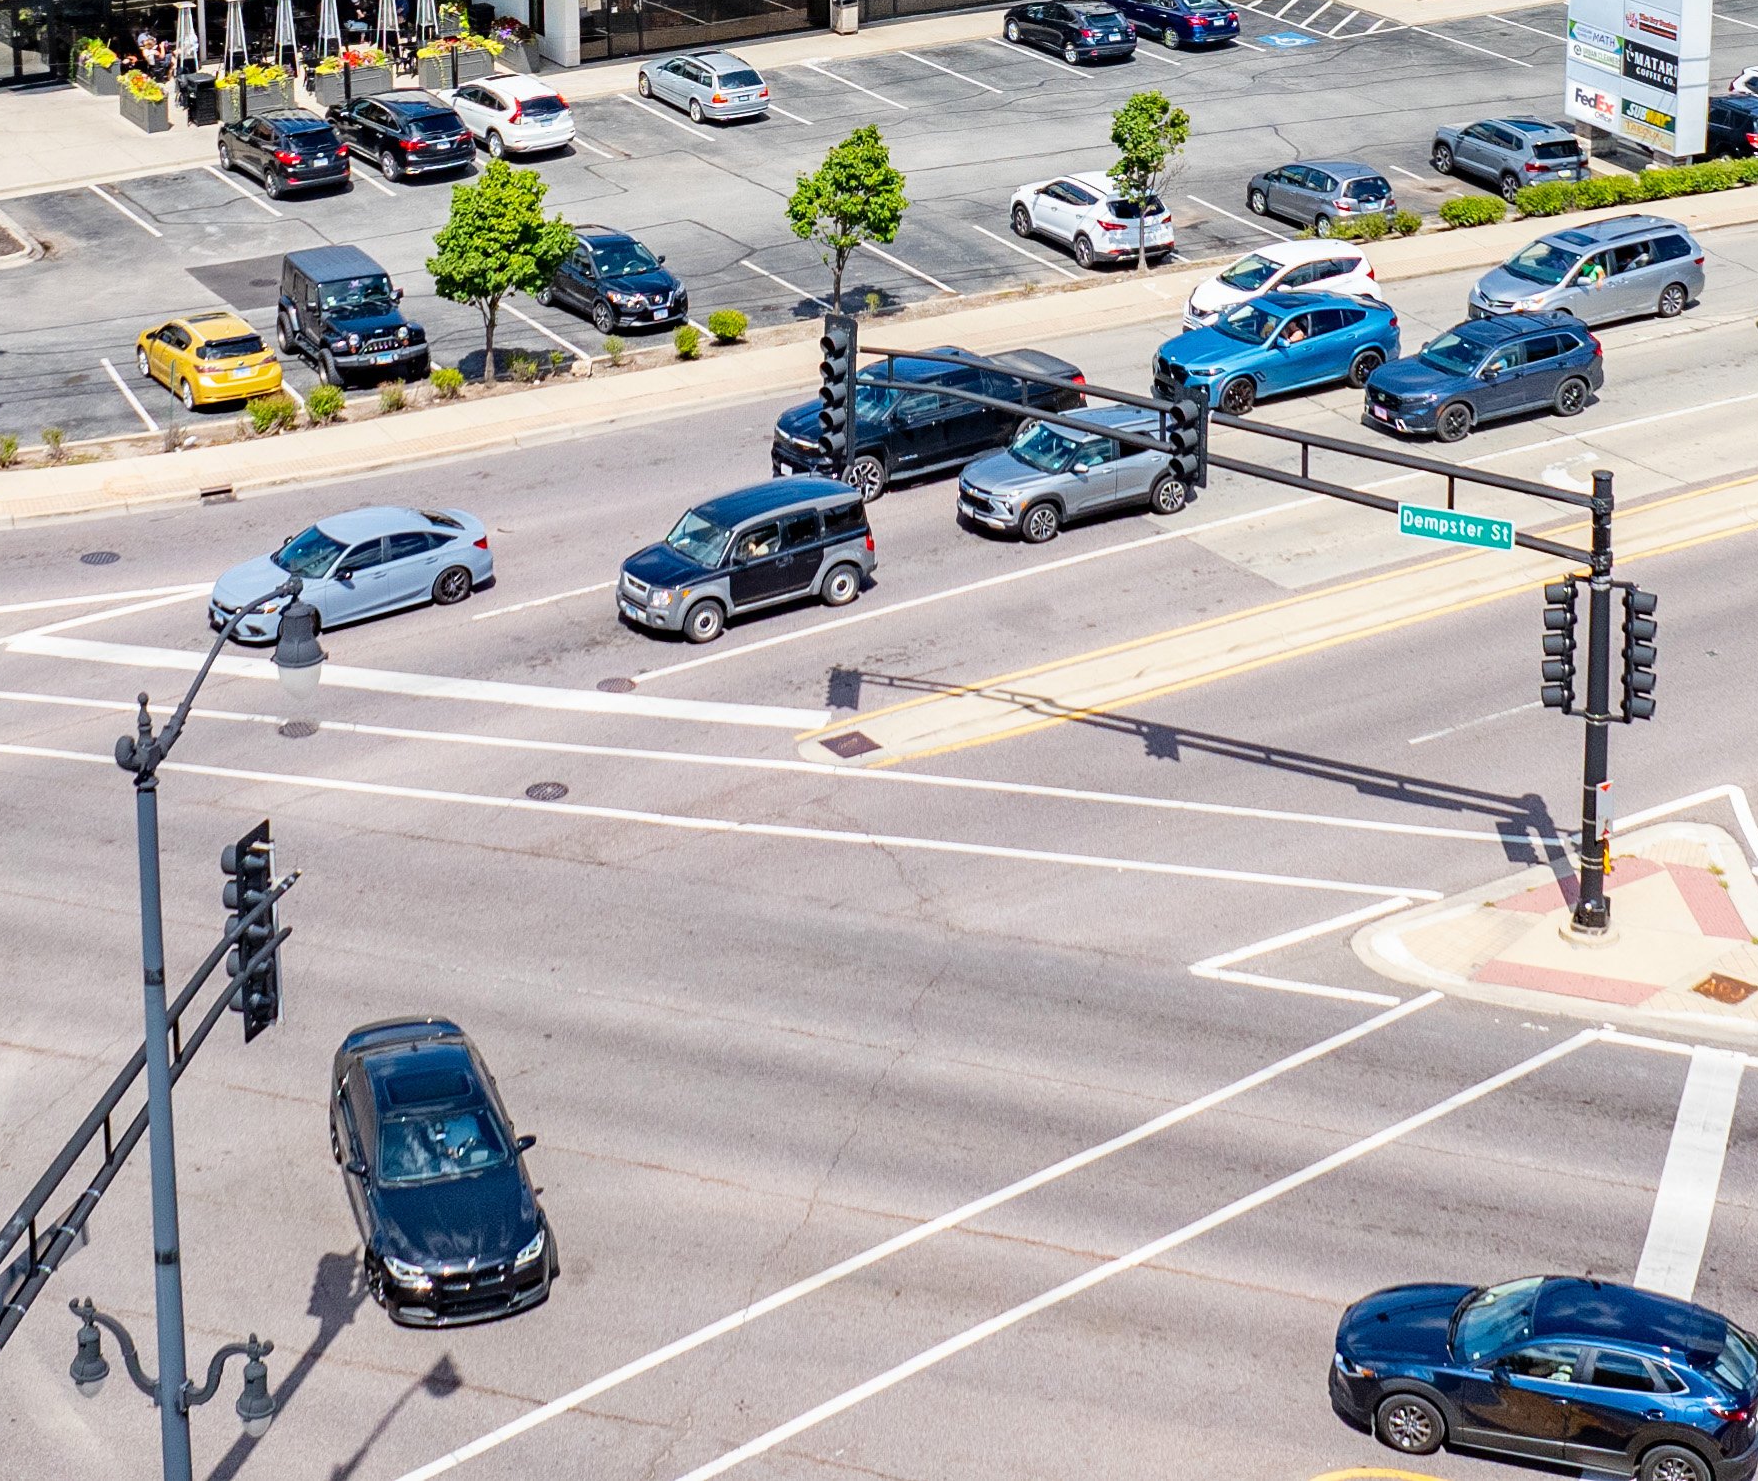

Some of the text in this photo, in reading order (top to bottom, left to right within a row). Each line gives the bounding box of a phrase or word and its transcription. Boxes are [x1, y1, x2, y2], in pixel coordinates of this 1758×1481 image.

[1593, 32, 1616, 47] MATH
[1634, 51, 1678, 78] MATARI
[1635, 66, 1661, 82] COFFEE
[1575, 87, 1615, 115] FedEx
[1594, 110, 1613, 124] Office
[1626, 102, 1672, 128] SUBWAY
[1403, 510, 1509, 542] Dempster St
